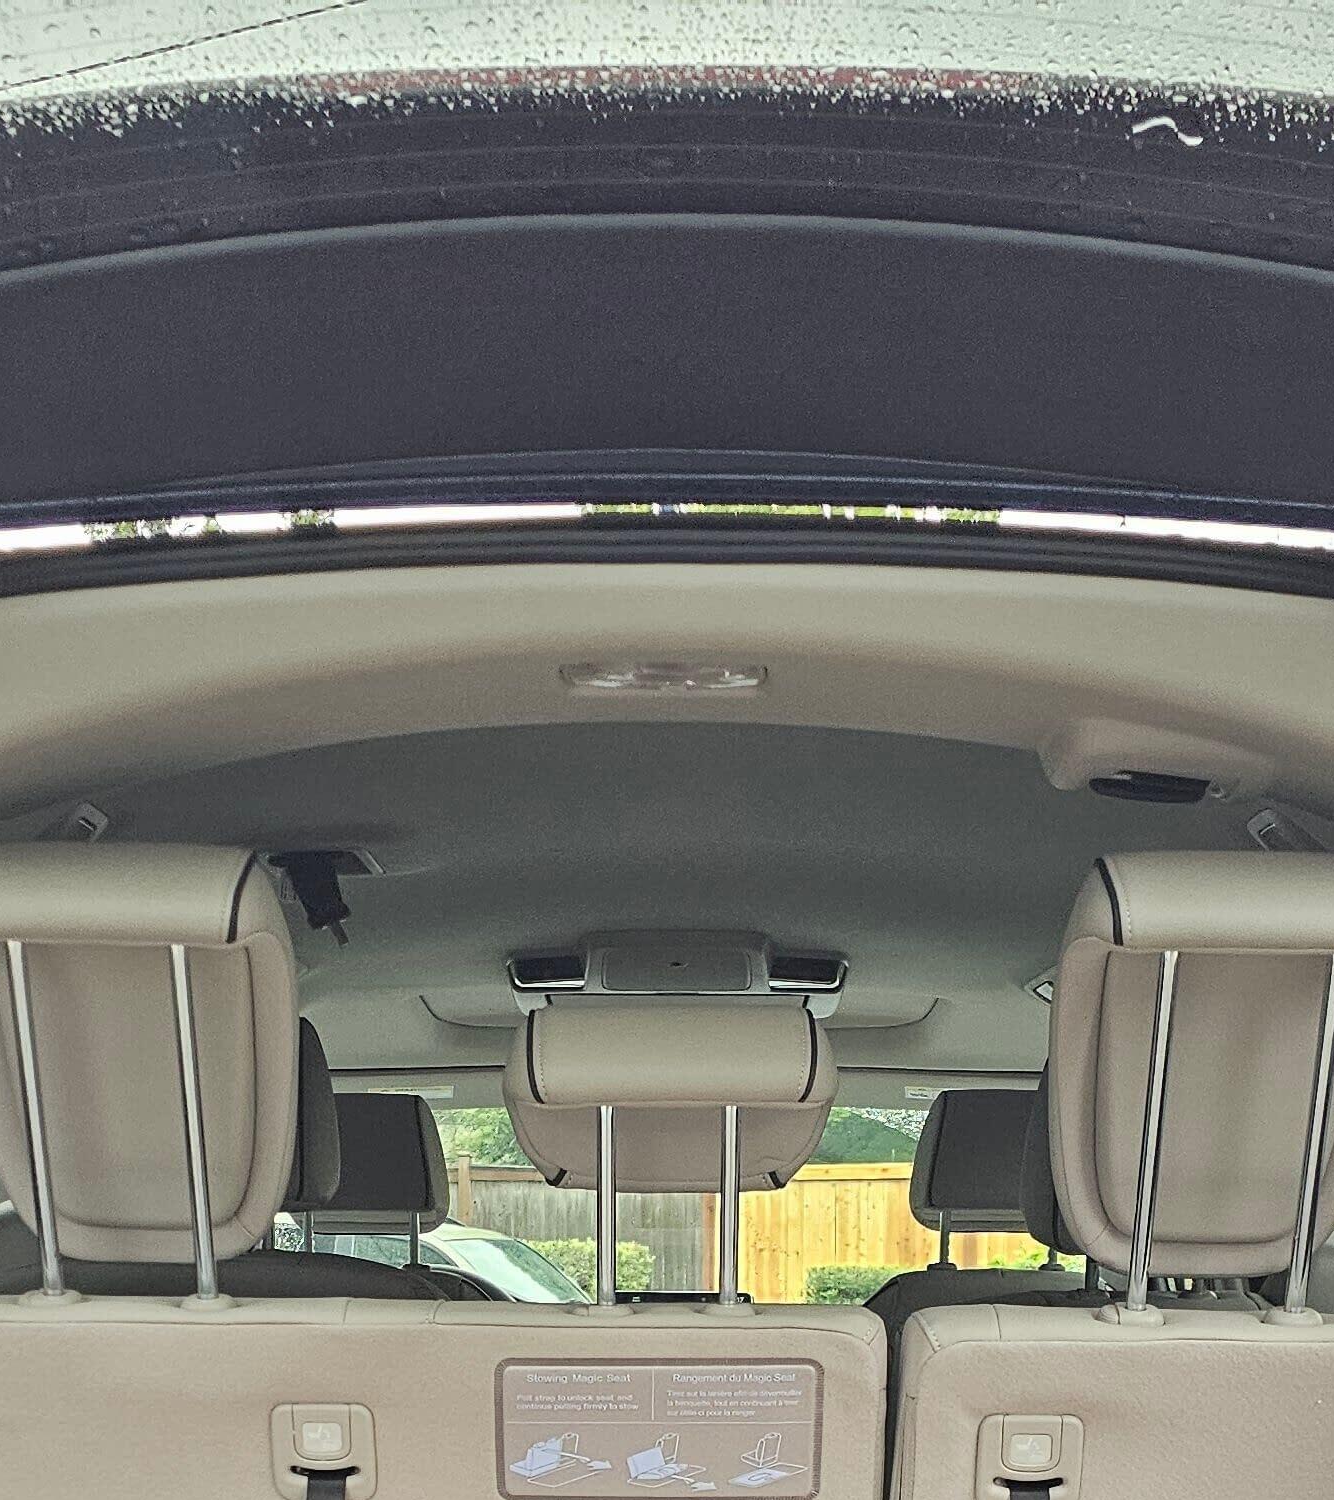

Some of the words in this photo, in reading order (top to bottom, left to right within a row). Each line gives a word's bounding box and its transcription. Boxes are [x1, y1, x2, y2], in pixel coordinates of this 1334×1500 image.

[526, 1373, 568, 1384] Stowing
[572, 1373, 603, 1384] Magic
[606, 1373, 631, 1383] Seat
[673, 1373, 727, 1384] Rangement
[729, 1373, 741, 1382] du
[744, 1373, 772, 1384] Magic
[773, 1373, 796, 1382] Seat
